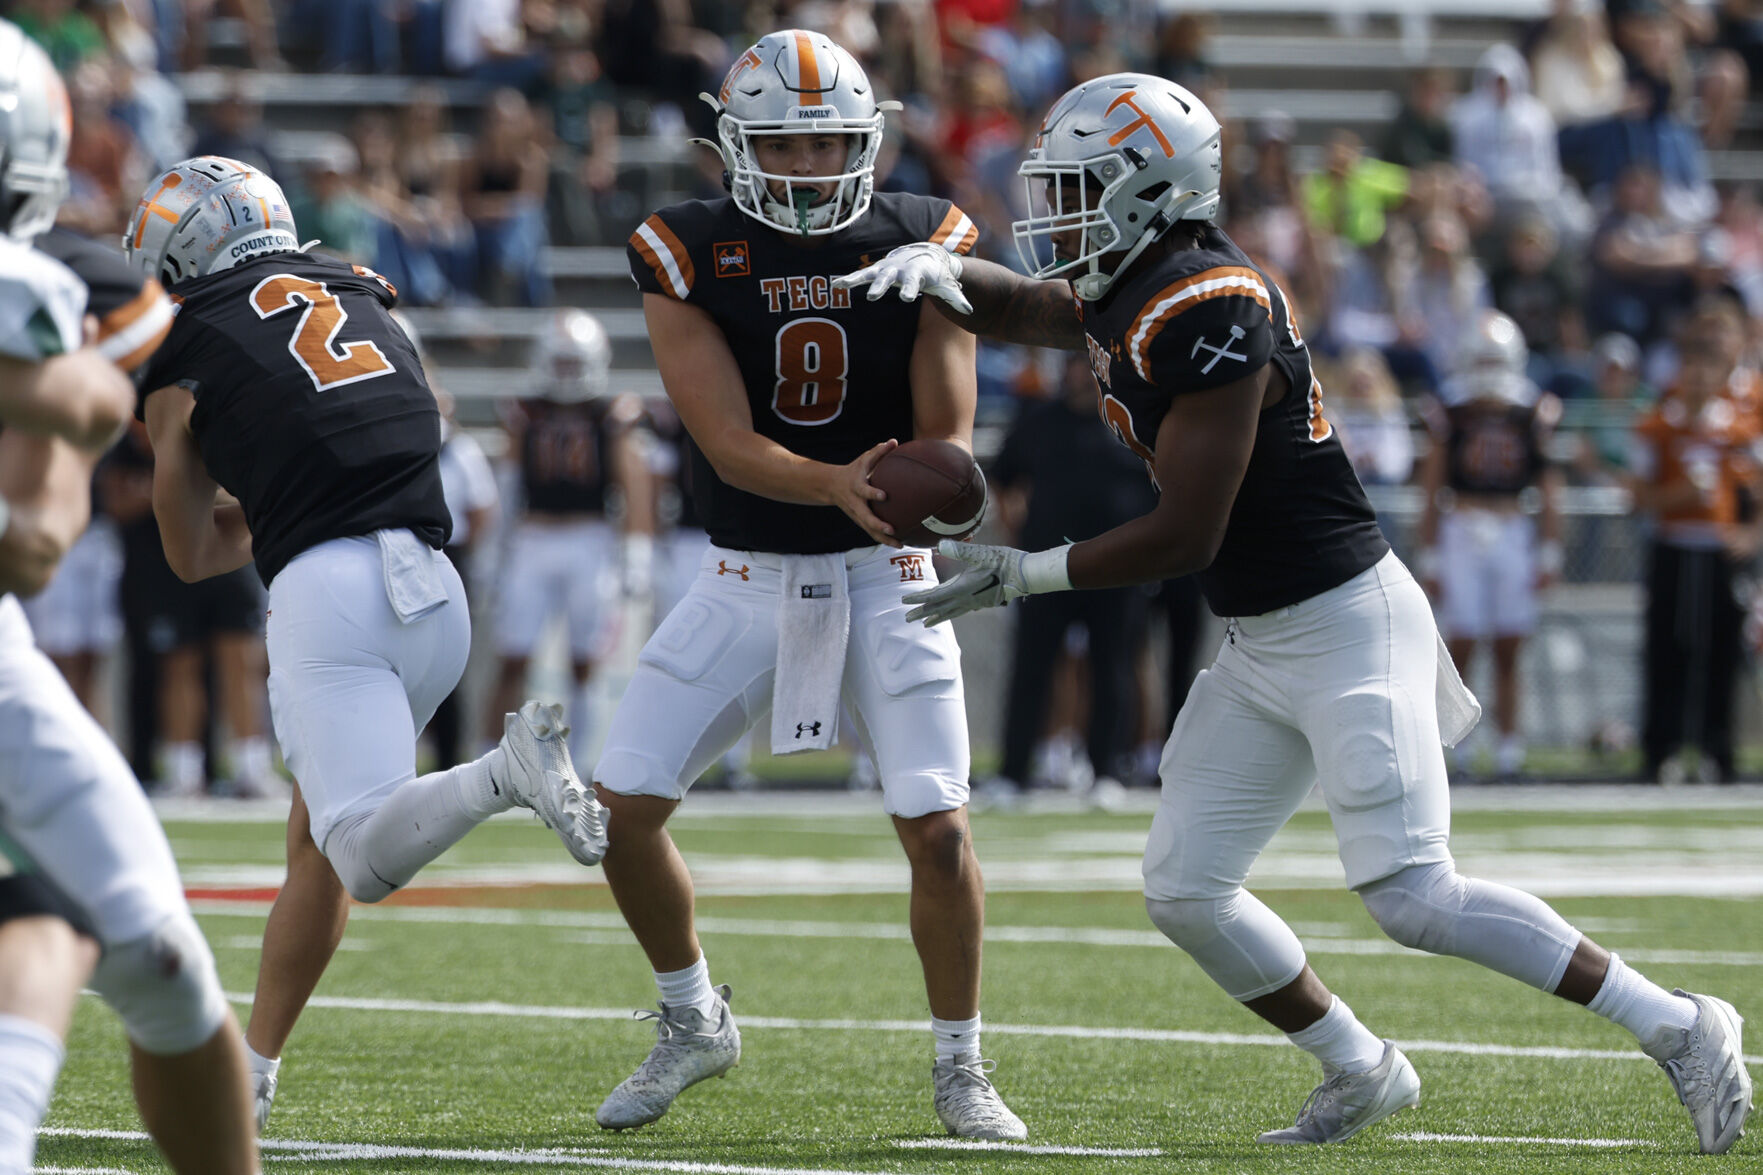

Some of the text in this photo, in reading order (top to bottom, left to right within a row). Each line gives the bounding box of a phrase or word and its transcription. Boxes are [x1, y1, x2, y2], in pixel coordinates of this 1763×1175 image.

[798, 109, 831, 119] FAMILY
[242, 206, 253, 222] 2
[231, 235, 274, 258] COUNT
[760, 275, 851, 313] TECH
[249, 273, 397, 392] 2
[771, 316, 849, 426] 8
